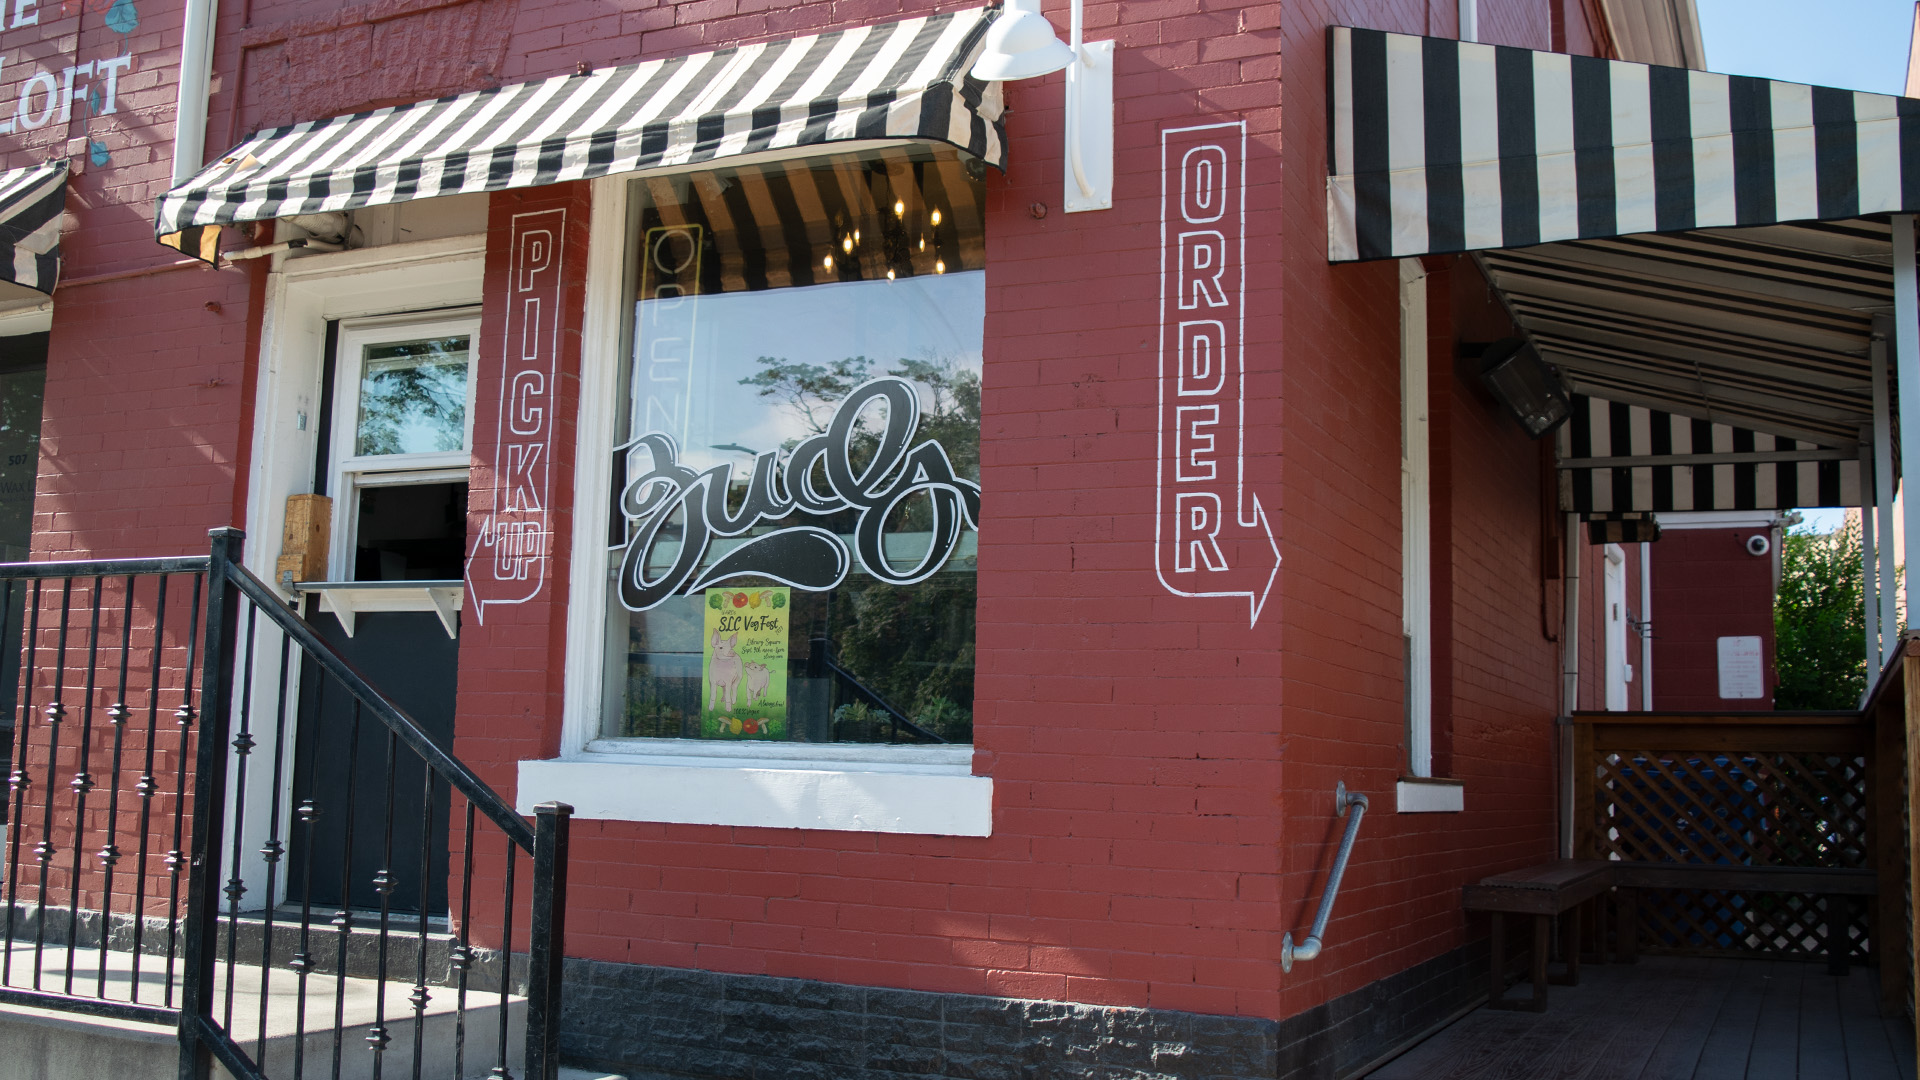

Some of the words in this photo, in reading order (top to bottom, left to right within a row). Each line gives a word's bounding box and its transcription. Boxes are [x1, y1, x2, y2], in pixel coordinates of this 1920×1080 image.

[505, 230, 552, 512] PICK
[647, 229, 695, 432] OPEN
[1175, 145, 1229, 572] ORDER
[8, 454, 28, 466] 507
[494, 521, 541, 581] UP
[719, 616, 741, 632] SLC
